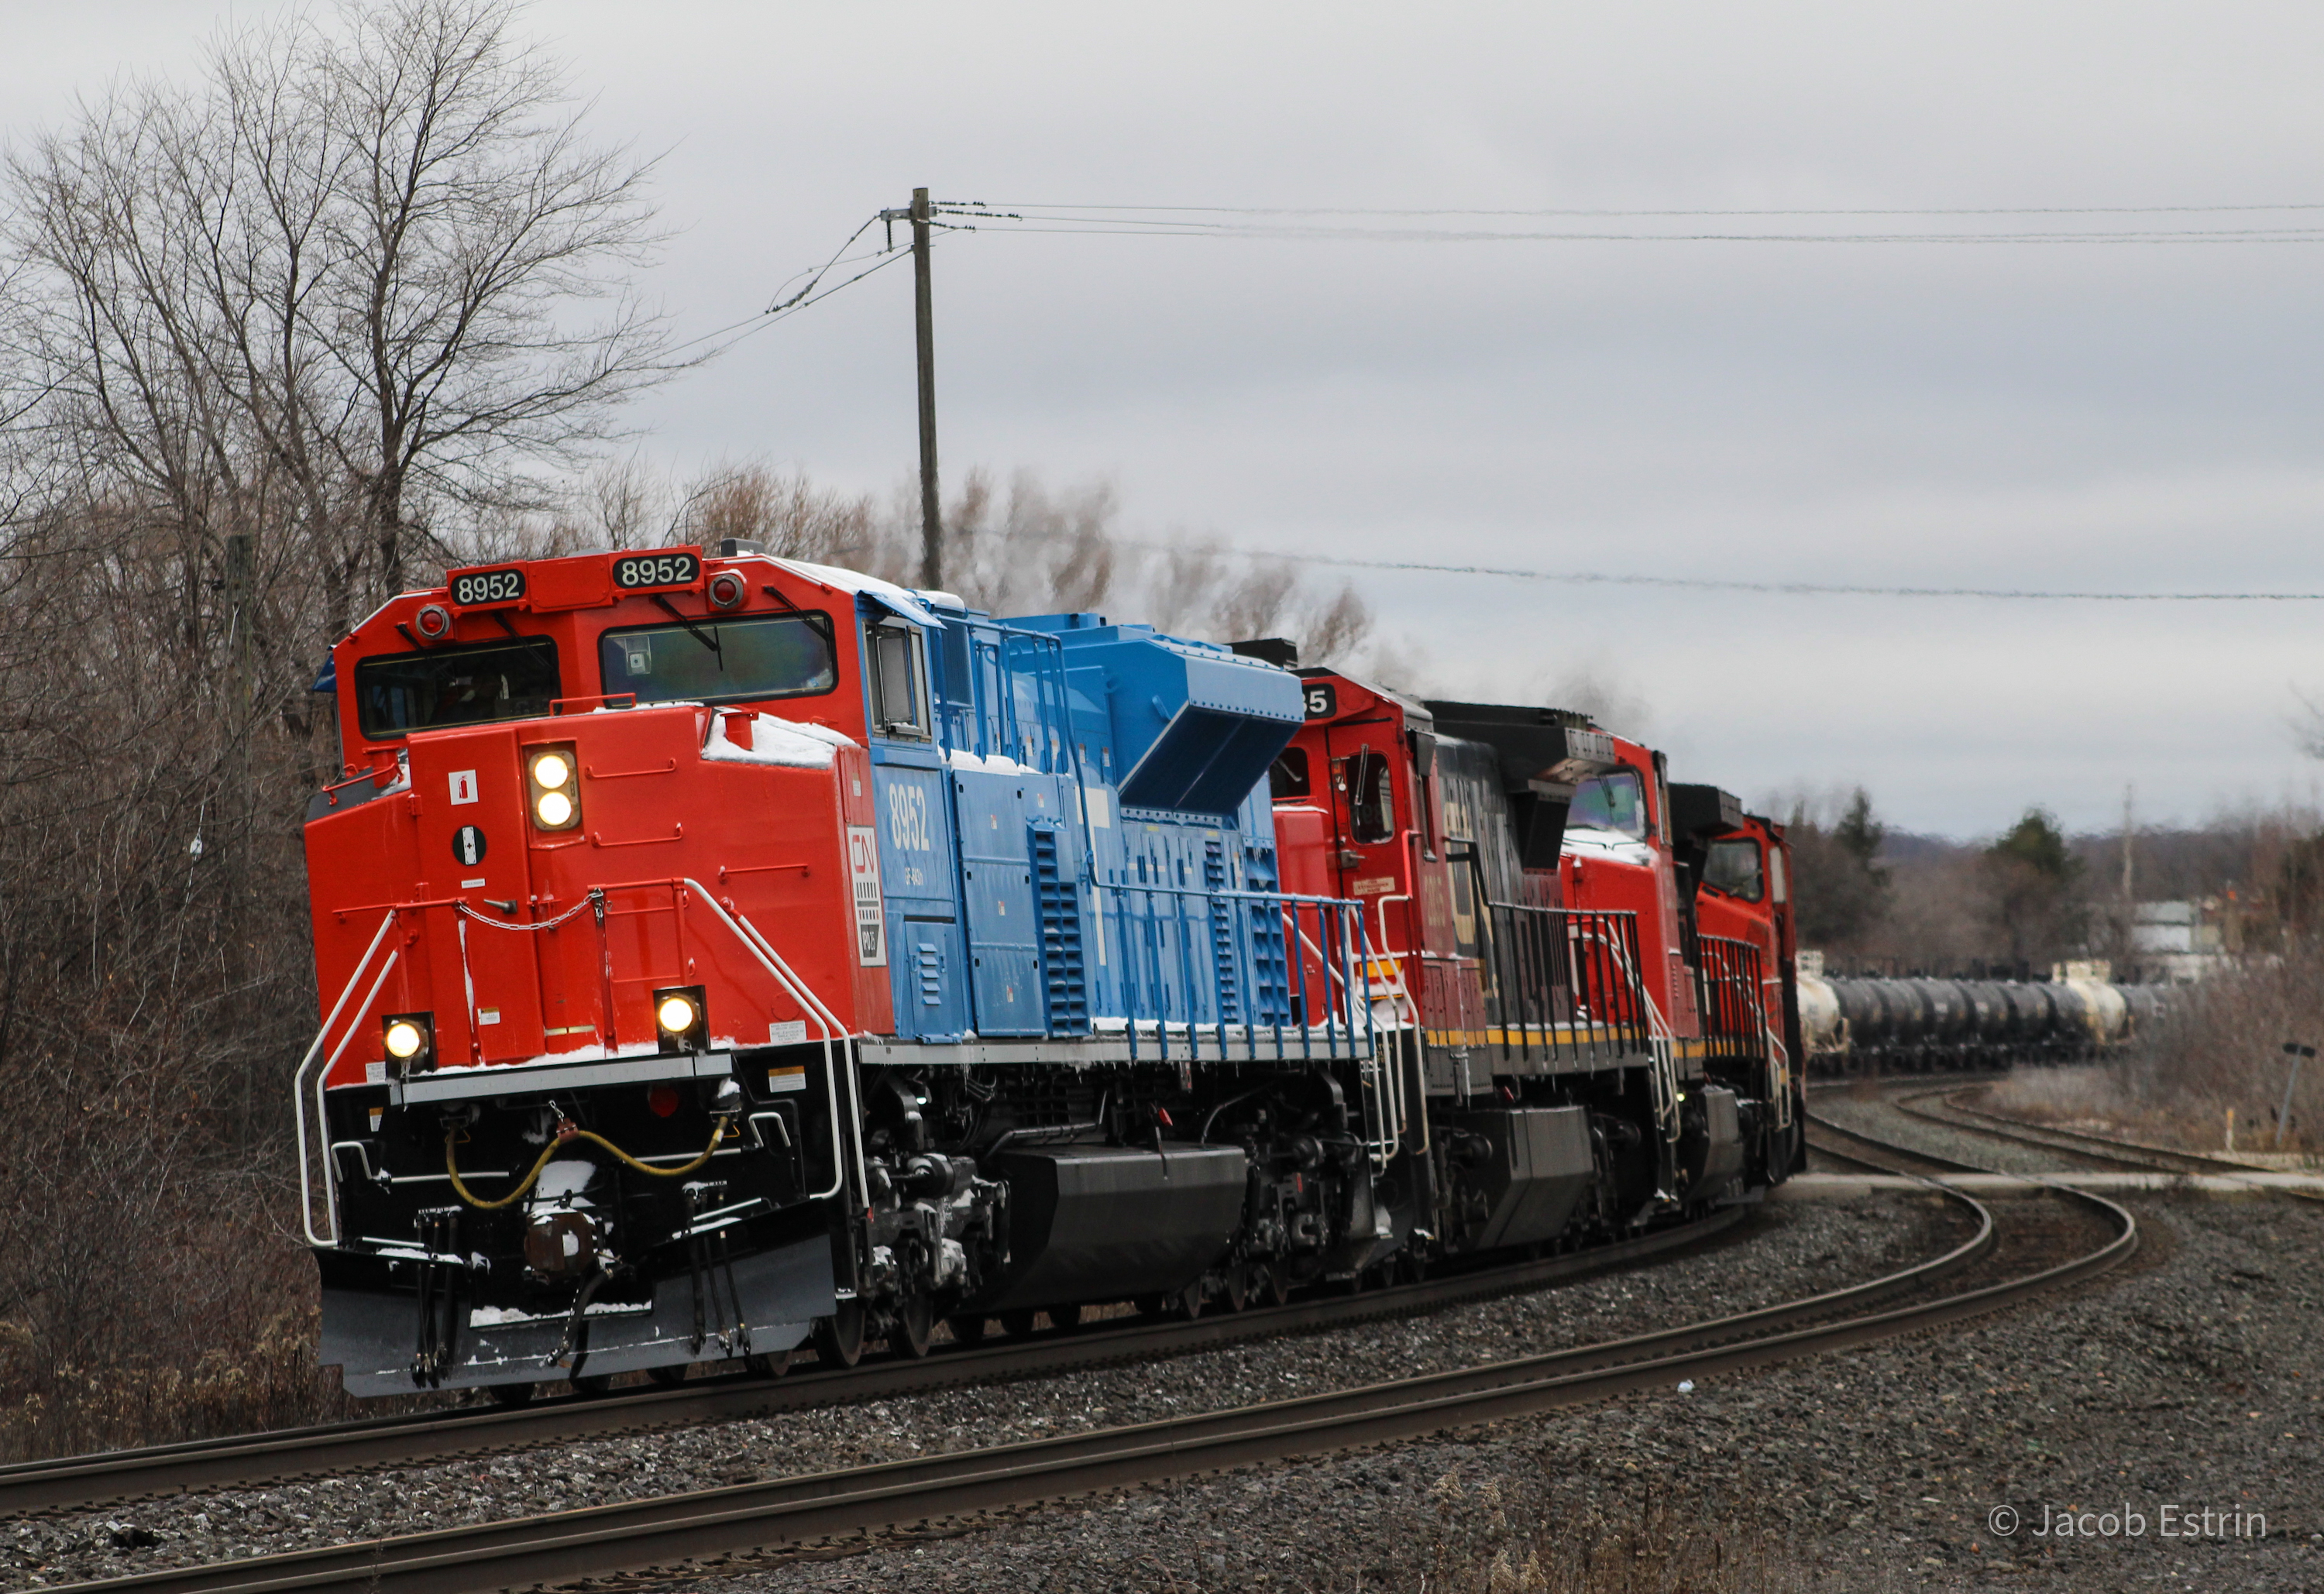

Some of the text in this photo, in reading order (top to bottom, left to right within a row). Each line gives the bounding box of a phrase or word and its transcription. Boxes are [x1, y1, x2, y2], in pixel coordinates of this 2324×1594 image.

[621, 557, 693, 586] 8952
[458, 573, 520, 603] 8952
[1302, 690, 1328, 713] 5
[889, 782, 930, 851] 8952
[852, 834, 875, 874] CN
